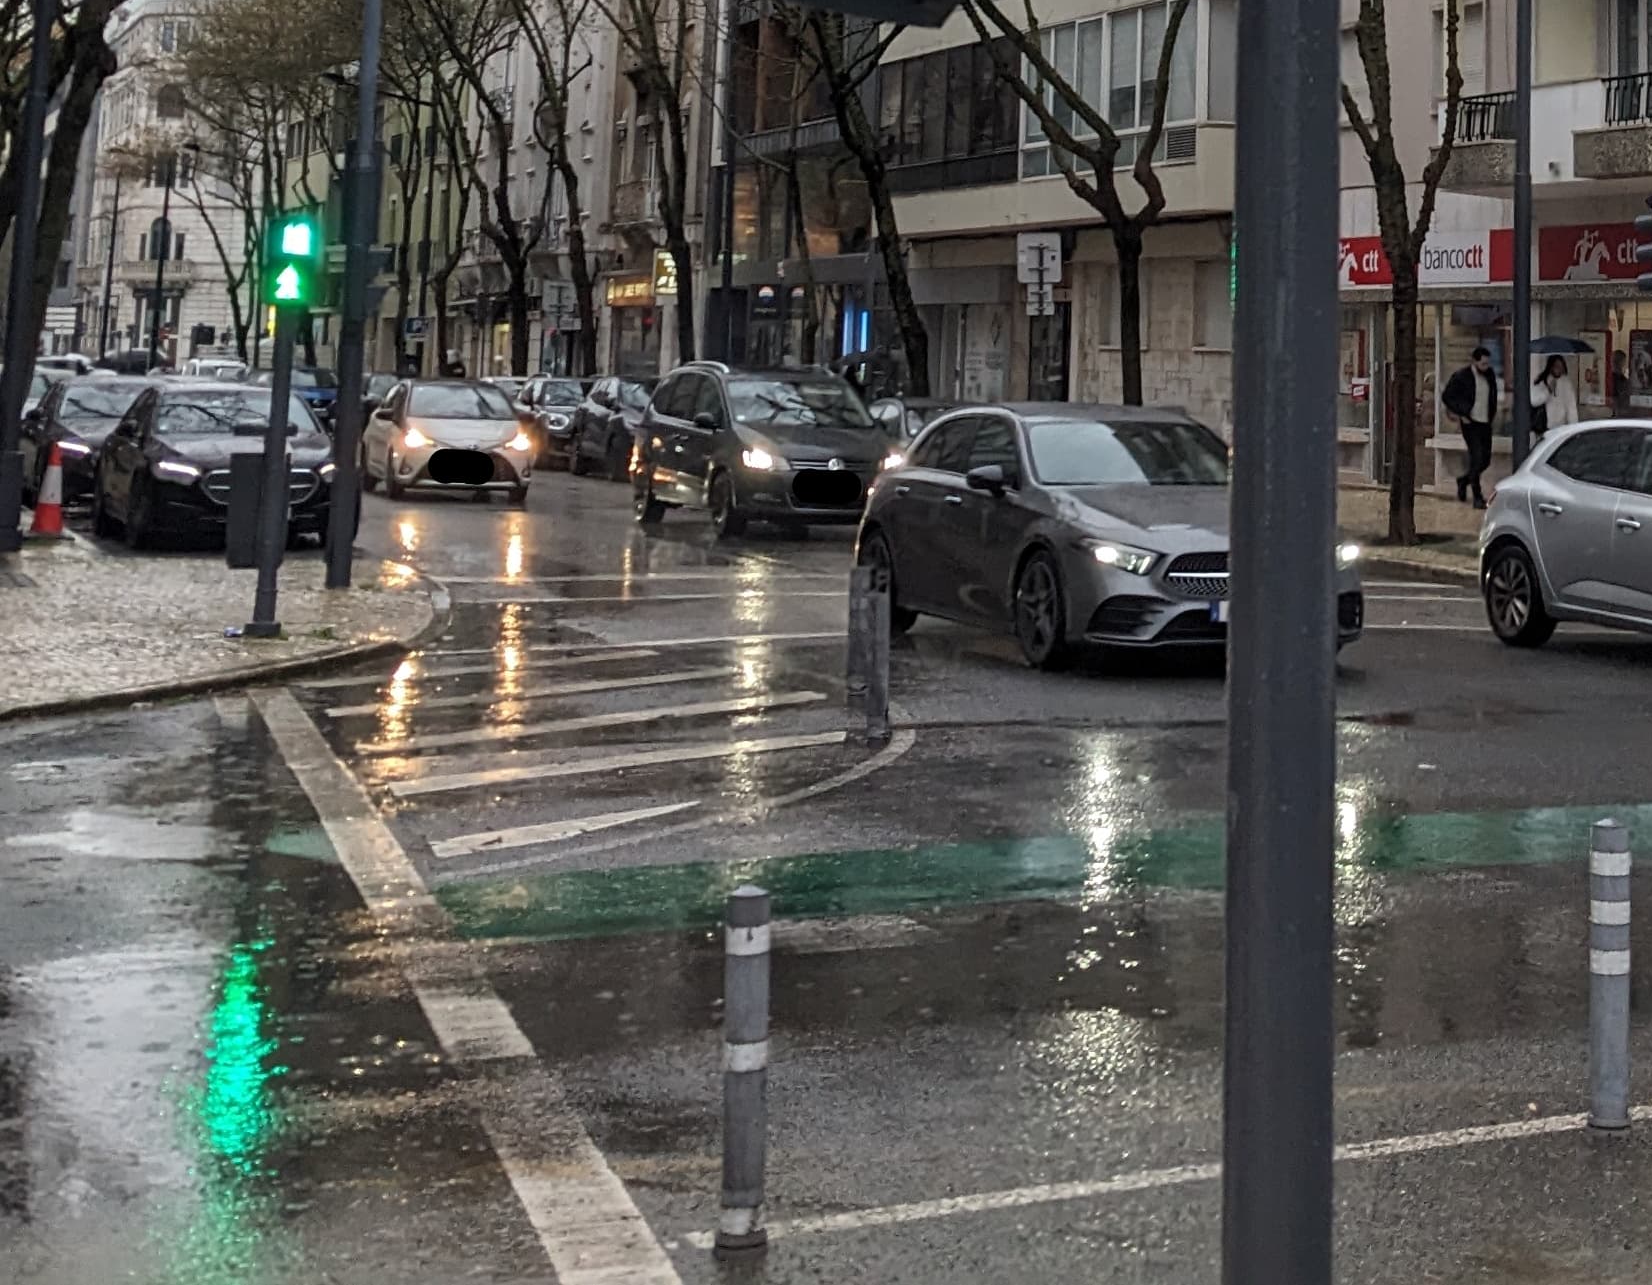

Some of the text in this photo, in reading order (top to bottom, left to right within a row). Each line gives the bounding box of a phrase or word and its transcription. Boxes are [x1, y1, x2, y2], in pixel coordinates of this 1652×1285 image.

[1362, 249, 1379, 273] ctt
[1424, 245, 1483, 269] bancoctt
[1617, 238, 1639, 264] ctt
